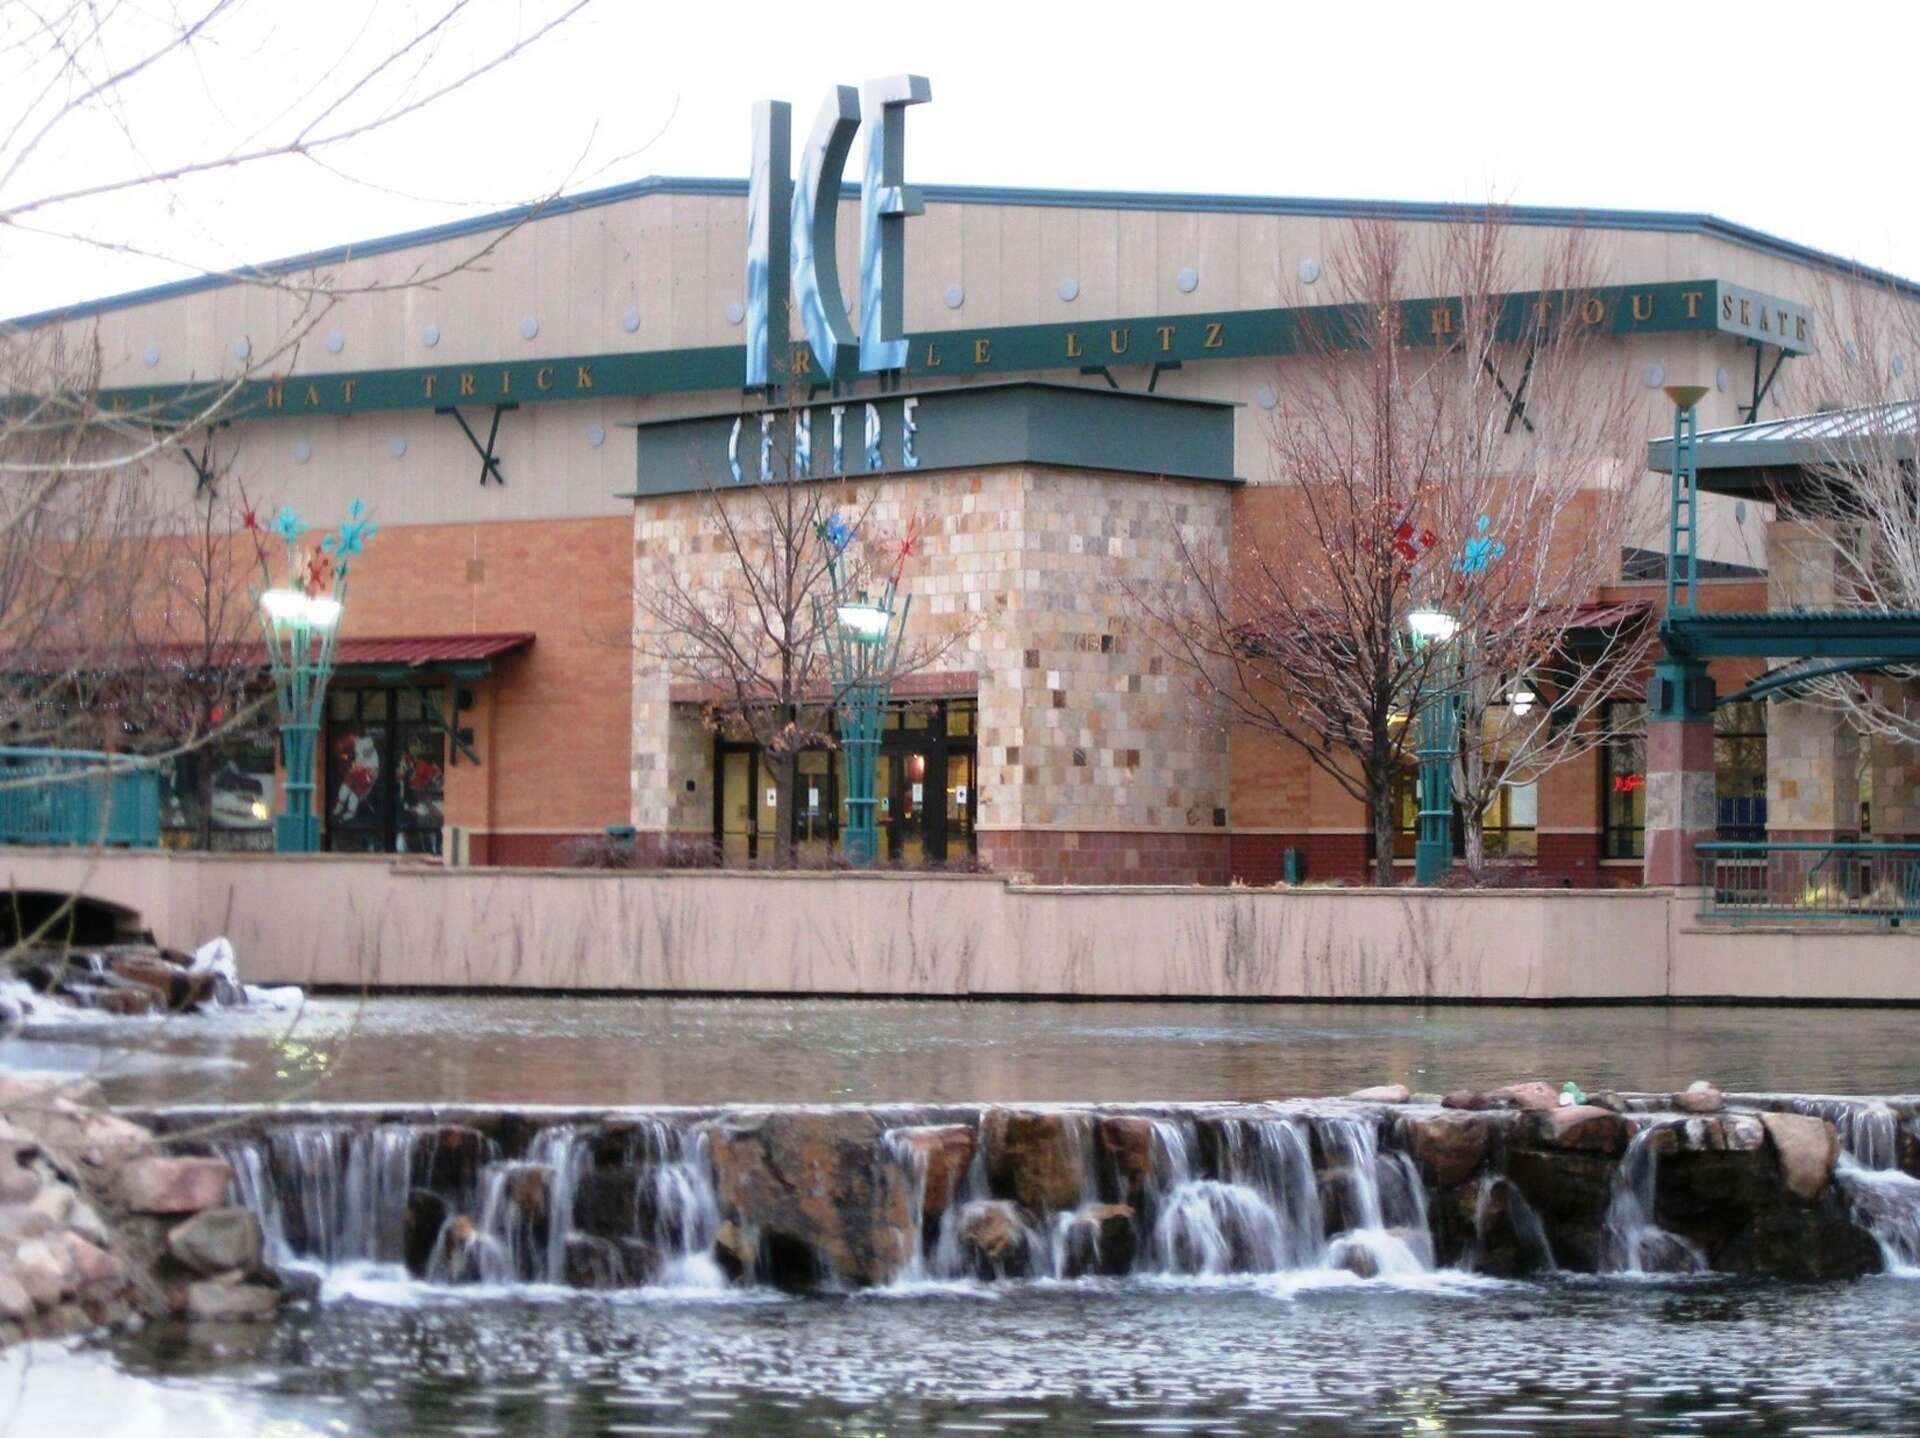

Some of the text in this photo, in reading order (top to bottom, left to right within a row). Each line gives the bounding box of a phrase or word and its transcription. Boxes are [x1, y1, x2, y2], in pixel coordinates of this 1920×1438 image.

[745, 74, 932, 386] ICE
[1065, 322, 1224, 358] LUTZ
[1721, 294, 1806, 342] SKATE
[265, 364, 594, 409] HAT TRICK
[728, 397, 921, 483] CENTRE
